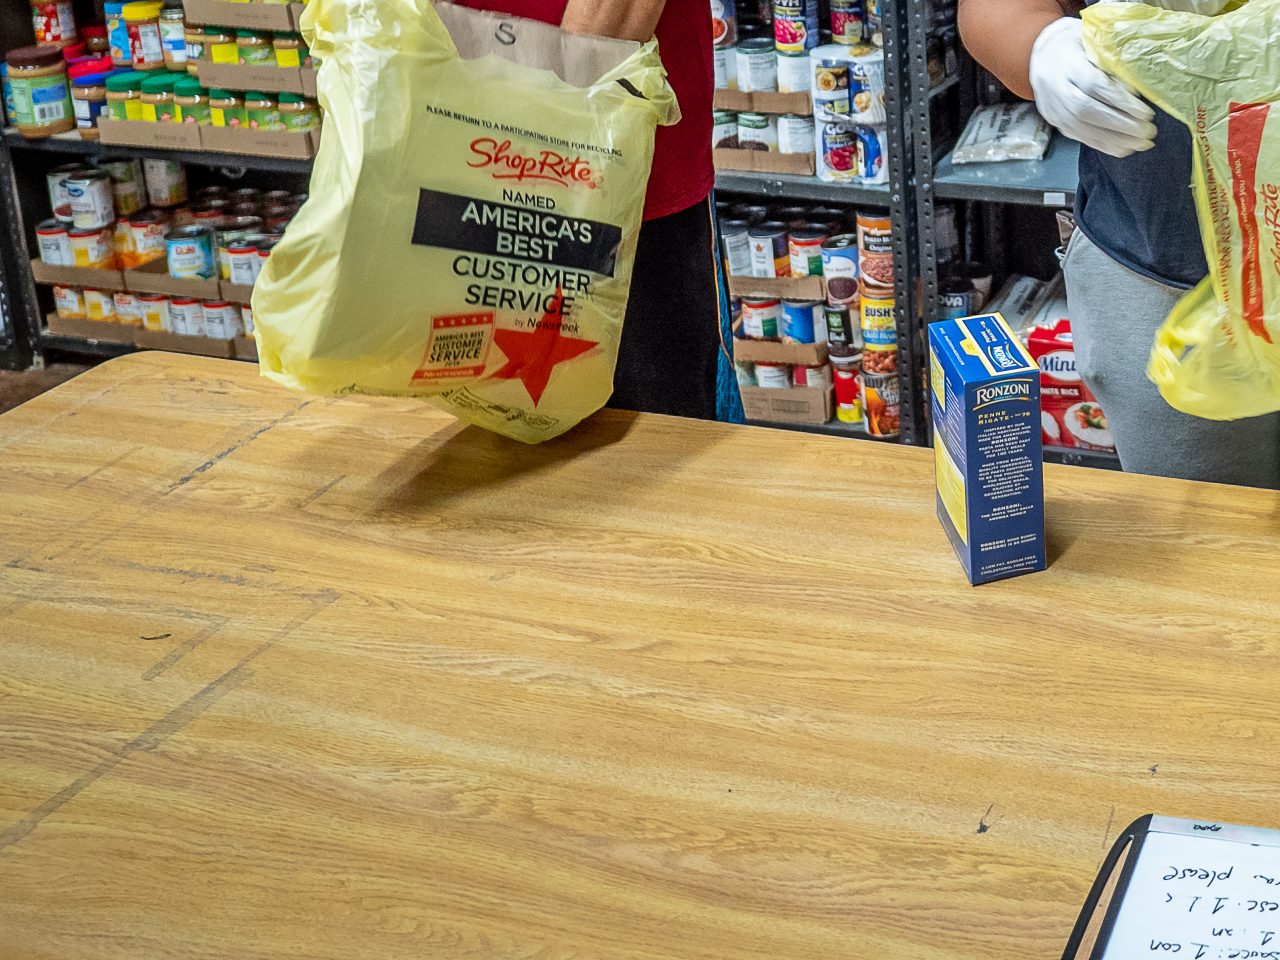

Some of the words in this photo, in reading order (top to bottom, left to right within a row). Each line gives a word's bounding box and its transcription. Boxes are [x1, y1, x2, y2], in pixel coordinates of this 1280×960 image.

[495, 23, 516, 46] S
[426, 104, 452, 119] PLEASE
[453, 112, 480, 127] RETURN
[482, 119, 492, 129] TO
[493, 122, 500, 130] A
[500, 124, 549, 144] PARTICIPATING
[550, 136, 570, 148] STORE
[571, 141, 586, 151] FOR
[826, 122, 846, 135] GO
[466, 138, 592, 187] ShopRite
[1239, 179, 1248, 196] you
[503, 188, 556, 210] NAMED
[1240, 197, 1248, 223] where
[462, 202, 592, 244] AMERICA'S
[496, 232, 558, 261] BEST
[869, 243, 893, 252] Origina
[453, 255, 590, 293] CUSTOMER
[465, 284, 575, 315] SERVICE
[514, 318, 525, 329] by
[527, 317, 580, 335] Newsweek
[428, 348, 481, 364] SERVICE
[432, 339, 483, 352] CUSTOMER
[977, 383, 1029, 405] RONZONI
[978, 410, 1007, 420] PENNE
[978, 415, 1009, 426] RIGATE
[1163, 866, 1233, 888] please
[1150, 940, 1182, 954] can
